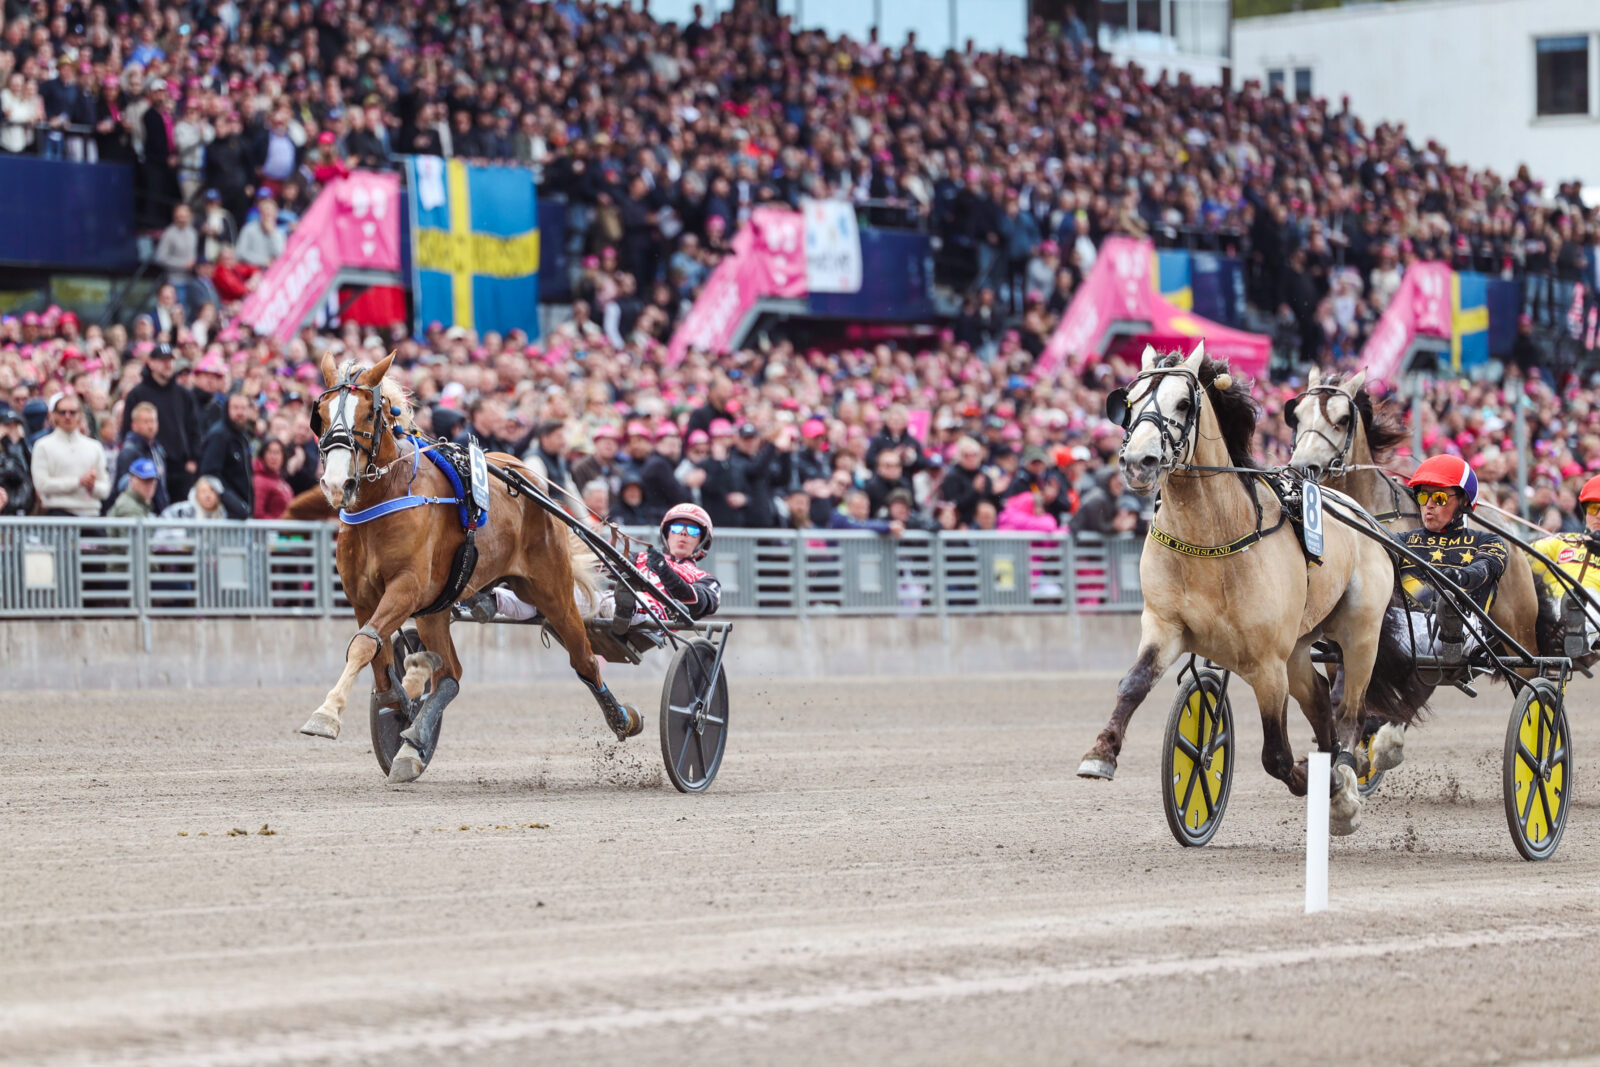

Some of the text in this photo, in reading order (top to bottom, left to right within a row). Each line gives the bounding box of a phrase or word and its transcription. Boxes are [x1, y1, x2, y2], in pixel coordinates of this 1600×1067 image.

[474, 448, 486, 488] 5
[1306, 484, 1318, 531] 8
[1151, 528, 1231, 557] TEAM TJOMSLAND
[1426, 535, 1475, 547] SEMU
